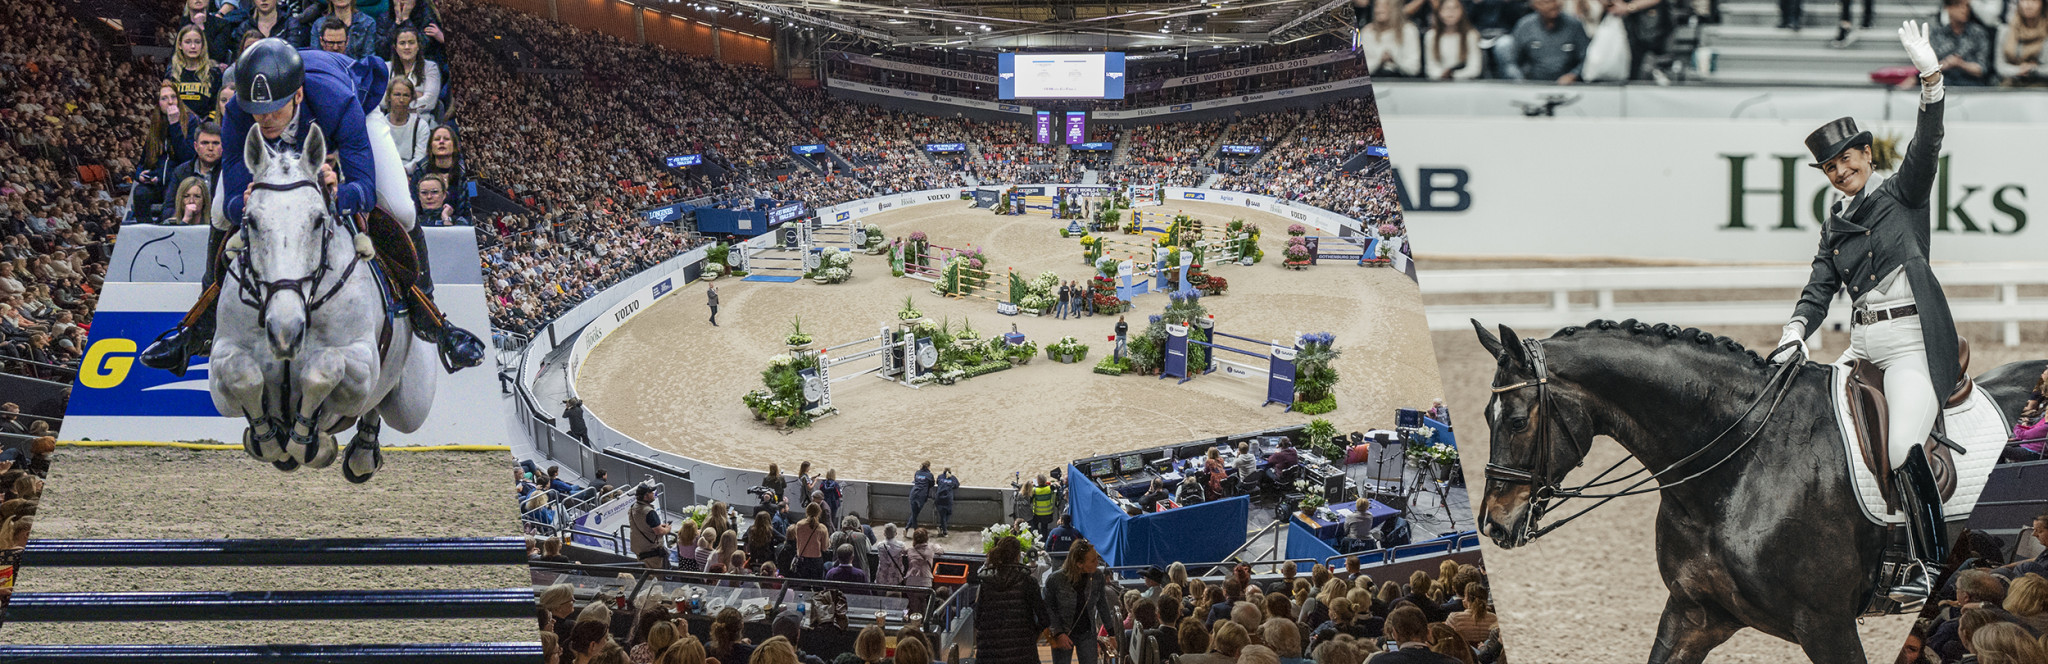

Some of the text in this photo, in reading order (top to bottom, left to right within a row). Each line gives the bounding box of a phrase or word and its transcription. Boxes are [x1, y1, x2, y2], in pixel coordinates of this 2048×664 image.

[886, 62, 996, 83] WELCOME TO GOTHENBURG
[1203, 70, 1233, 81] WORLD
[1233, 68, 1250, 77] CUP
[1255, 63, 1285, 73] FINALS
[1287, 59, 1308, 68] 2019
[1718, 149, 2030, 236] Hks
[1290, 210, 1307, 221] VOLVO
[614, 299, 640, 322] VOLVO
[79, 338, 137, 389] G
[884, 328, 892, 372] LONGNES
[907, 335, 915, 380] LONGINES
[821, 357, 831, 405] LONGINES
[1233, 368, 1246, 376] SAAB
